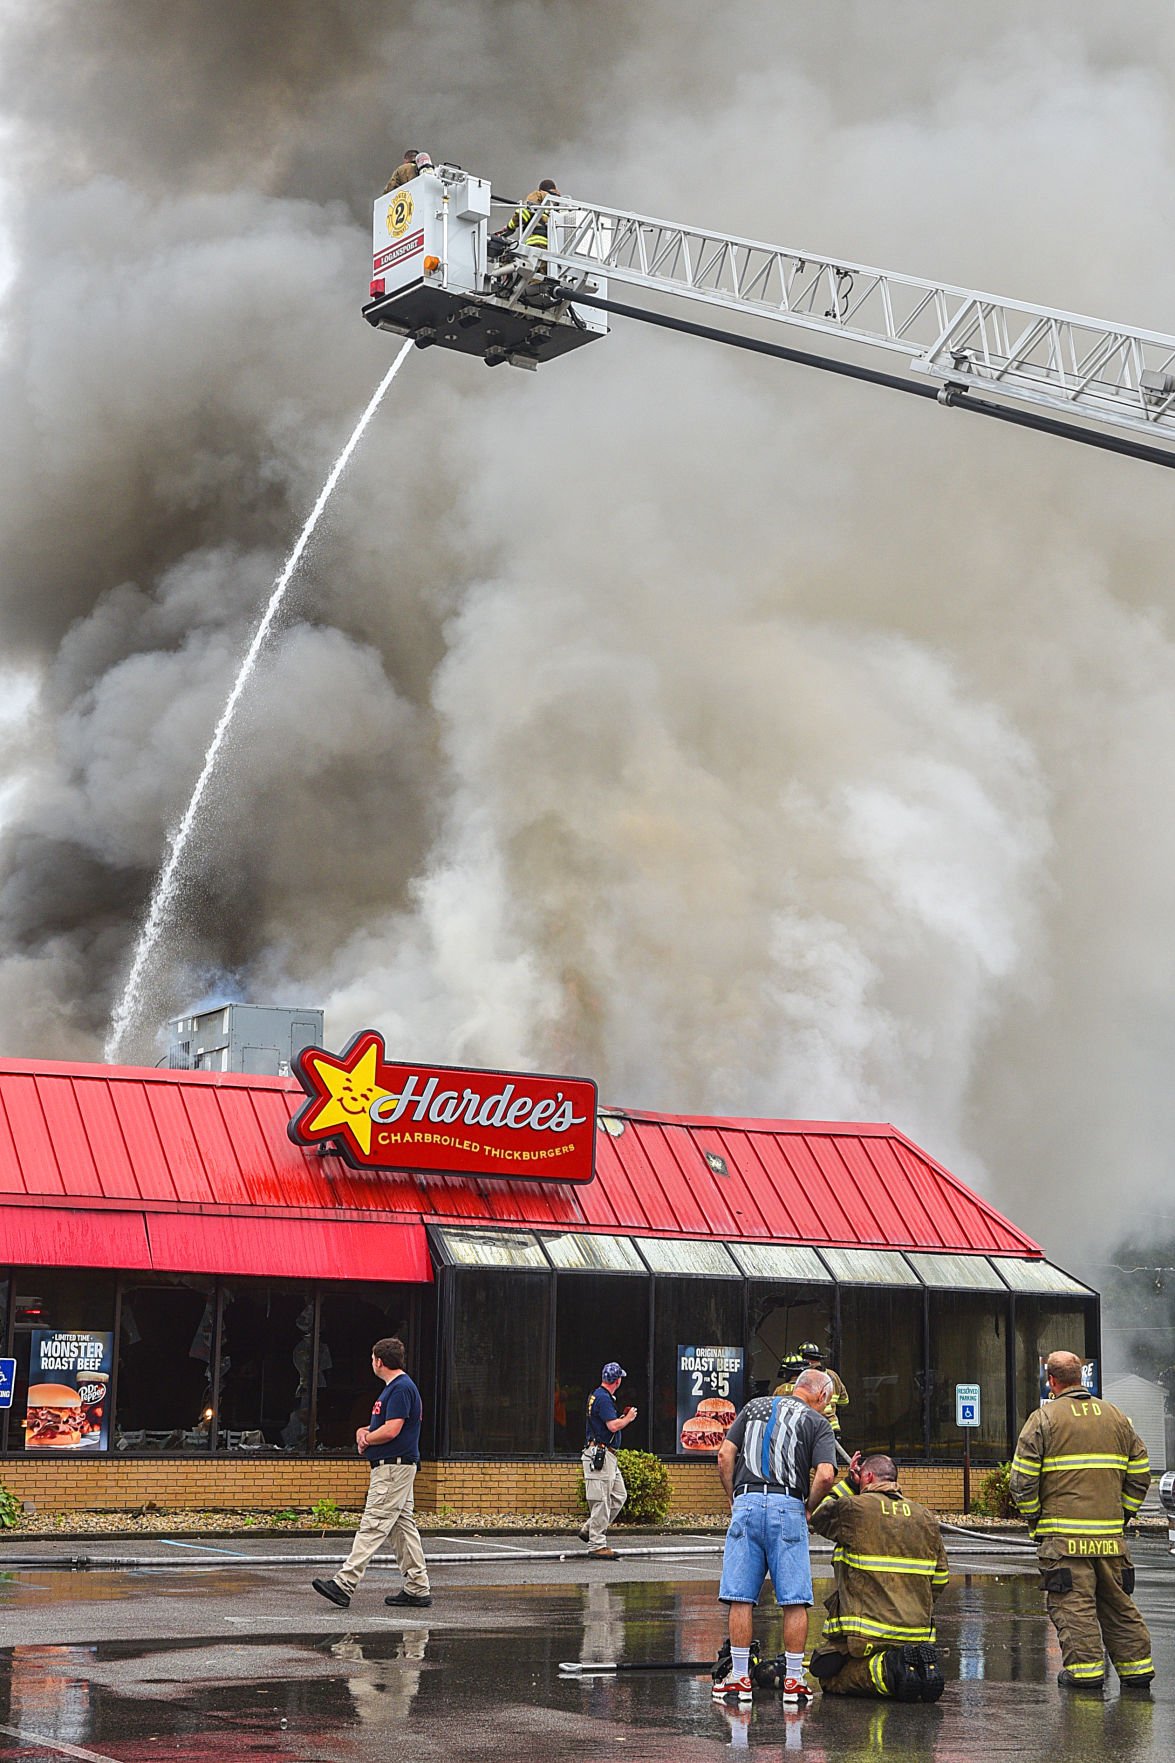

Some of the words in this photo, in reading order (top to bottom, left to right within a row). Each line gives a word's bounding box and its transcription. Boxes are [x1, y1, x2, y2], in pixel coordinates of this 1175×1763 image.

[395, 202, 405, 226] 2
[380, 240, 419, 265] LOGANSPORT
[370, 1075, 587, 1132] Hardee's
[377, 1131, 480, 1153] CHARBROILED
[483, 1143, 575, 1161] THICKBURGERS
[40, 1341, 104, 1358] MONSTER
[696, 1348, 725, 1357] ORIGINAL
[41, 1358, 75, 1370] ROAST
[76, 1359, 101, 1371] BEEF
[681, 1357, 714, 1371] ROAST
[716, 1359, 741, 1372] BEEF
[691, 1371, 703, 1396] 2
[1068, 1540, 1077, 1555] D
[1079, 1540, 1119, 1555] HAYDEN
